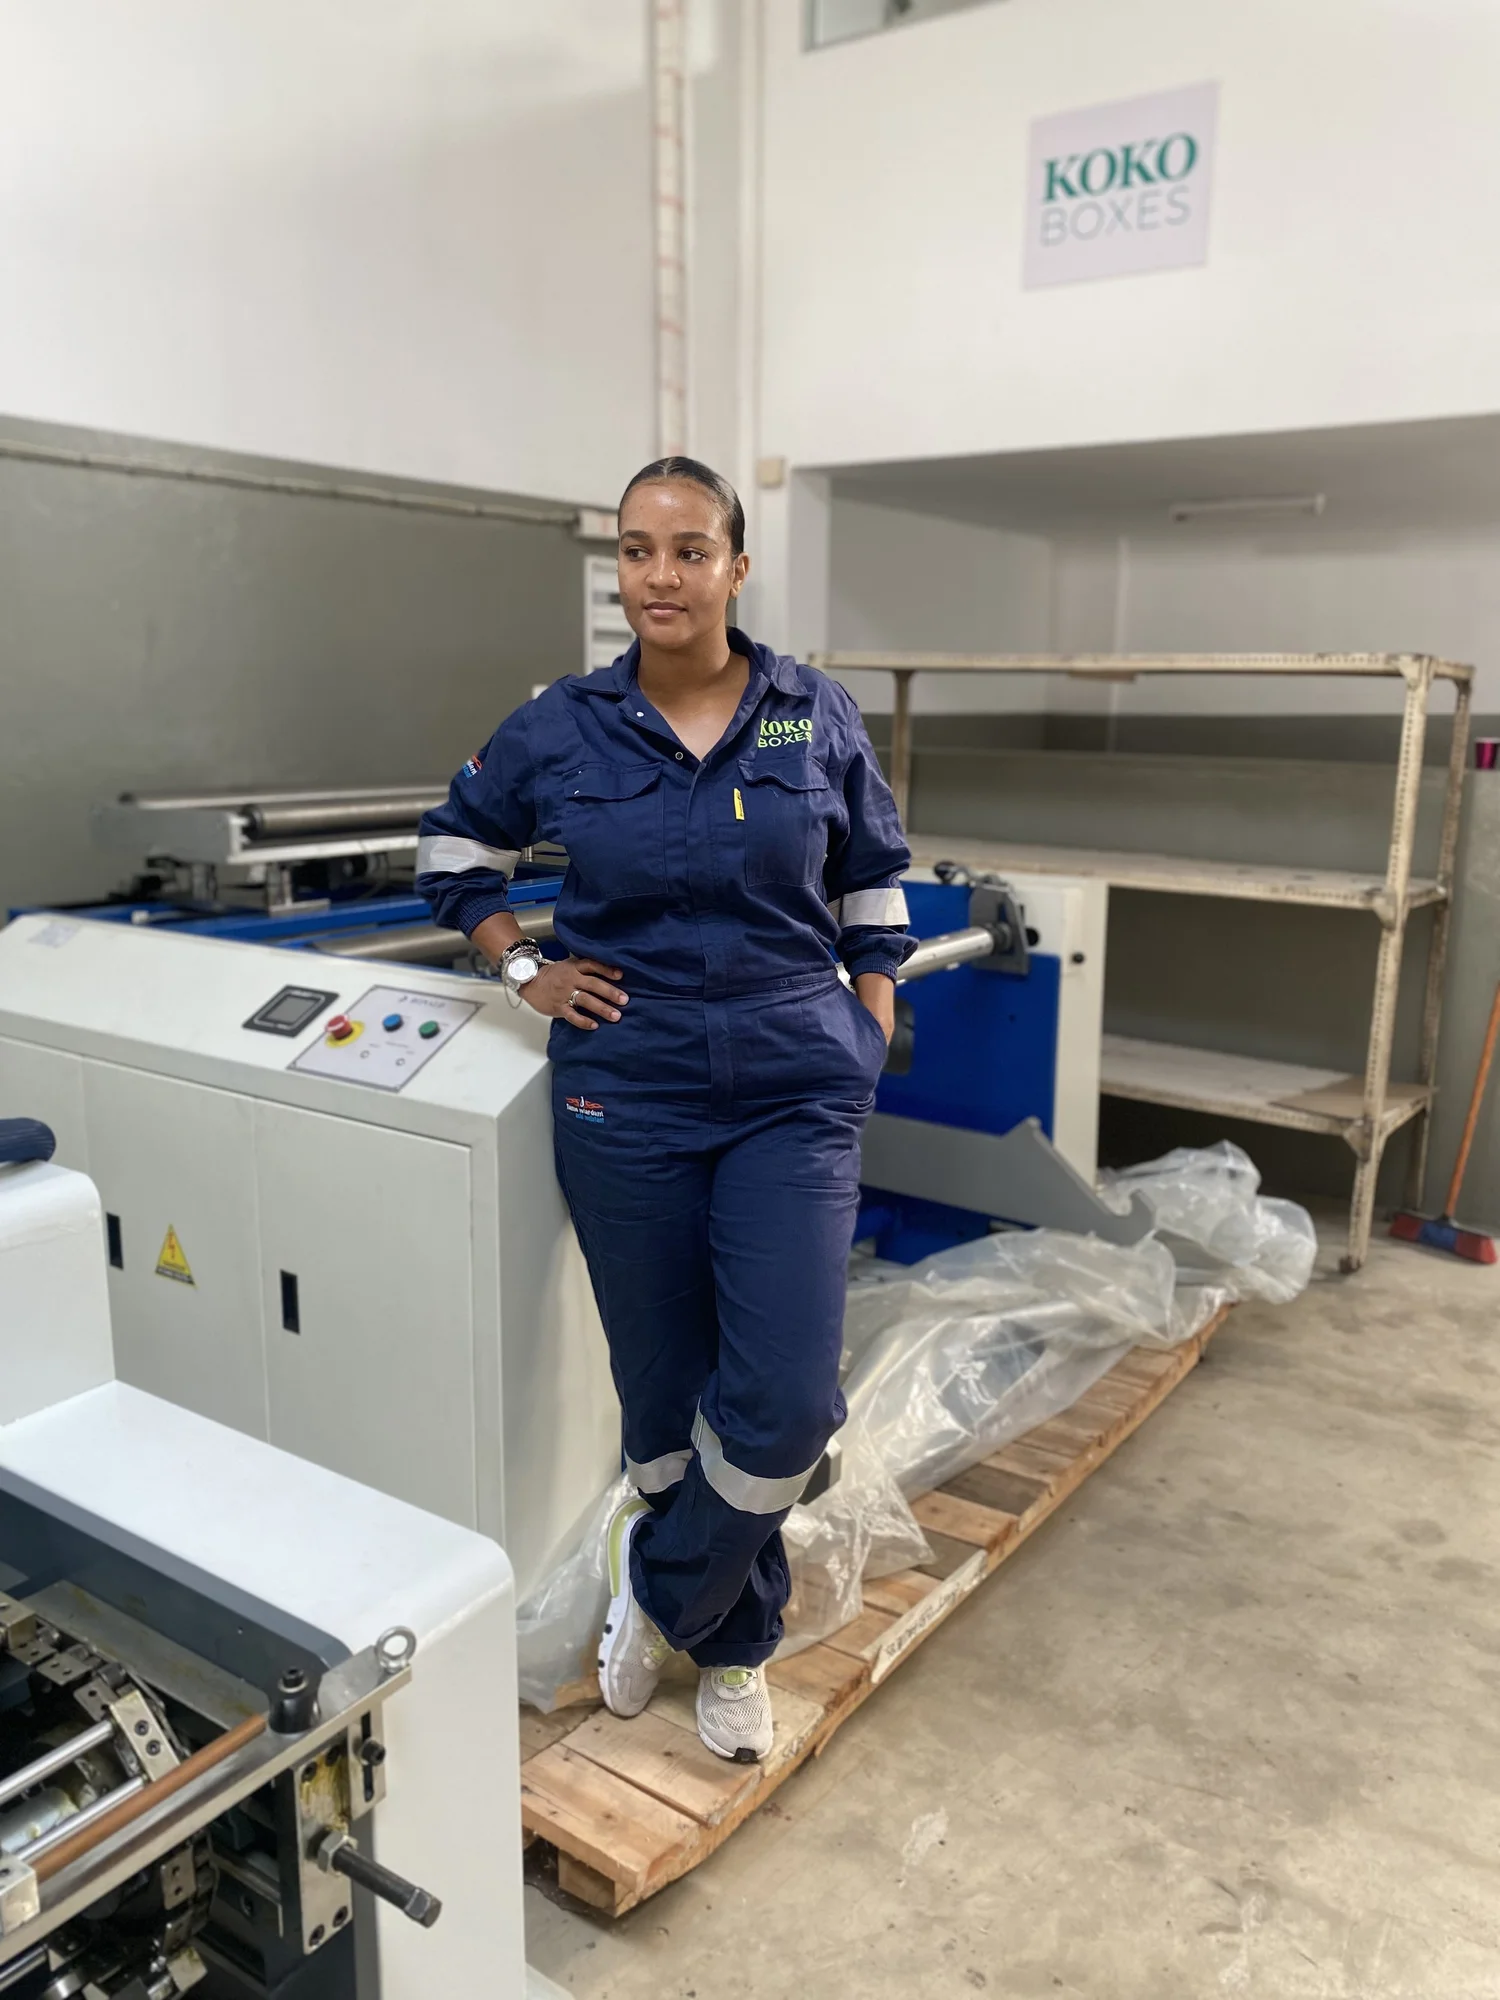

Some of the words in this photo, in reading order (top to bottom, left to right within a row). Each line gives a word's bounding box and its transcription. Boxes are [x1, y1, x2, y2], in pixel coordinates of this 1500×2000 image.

[1043, 131, 1199, 203] KOKO
[1039, 184, 1192, 247] BOXES
[758, 731, 812, 748] BOXES
[760, 718, 813, 736] KOKO
